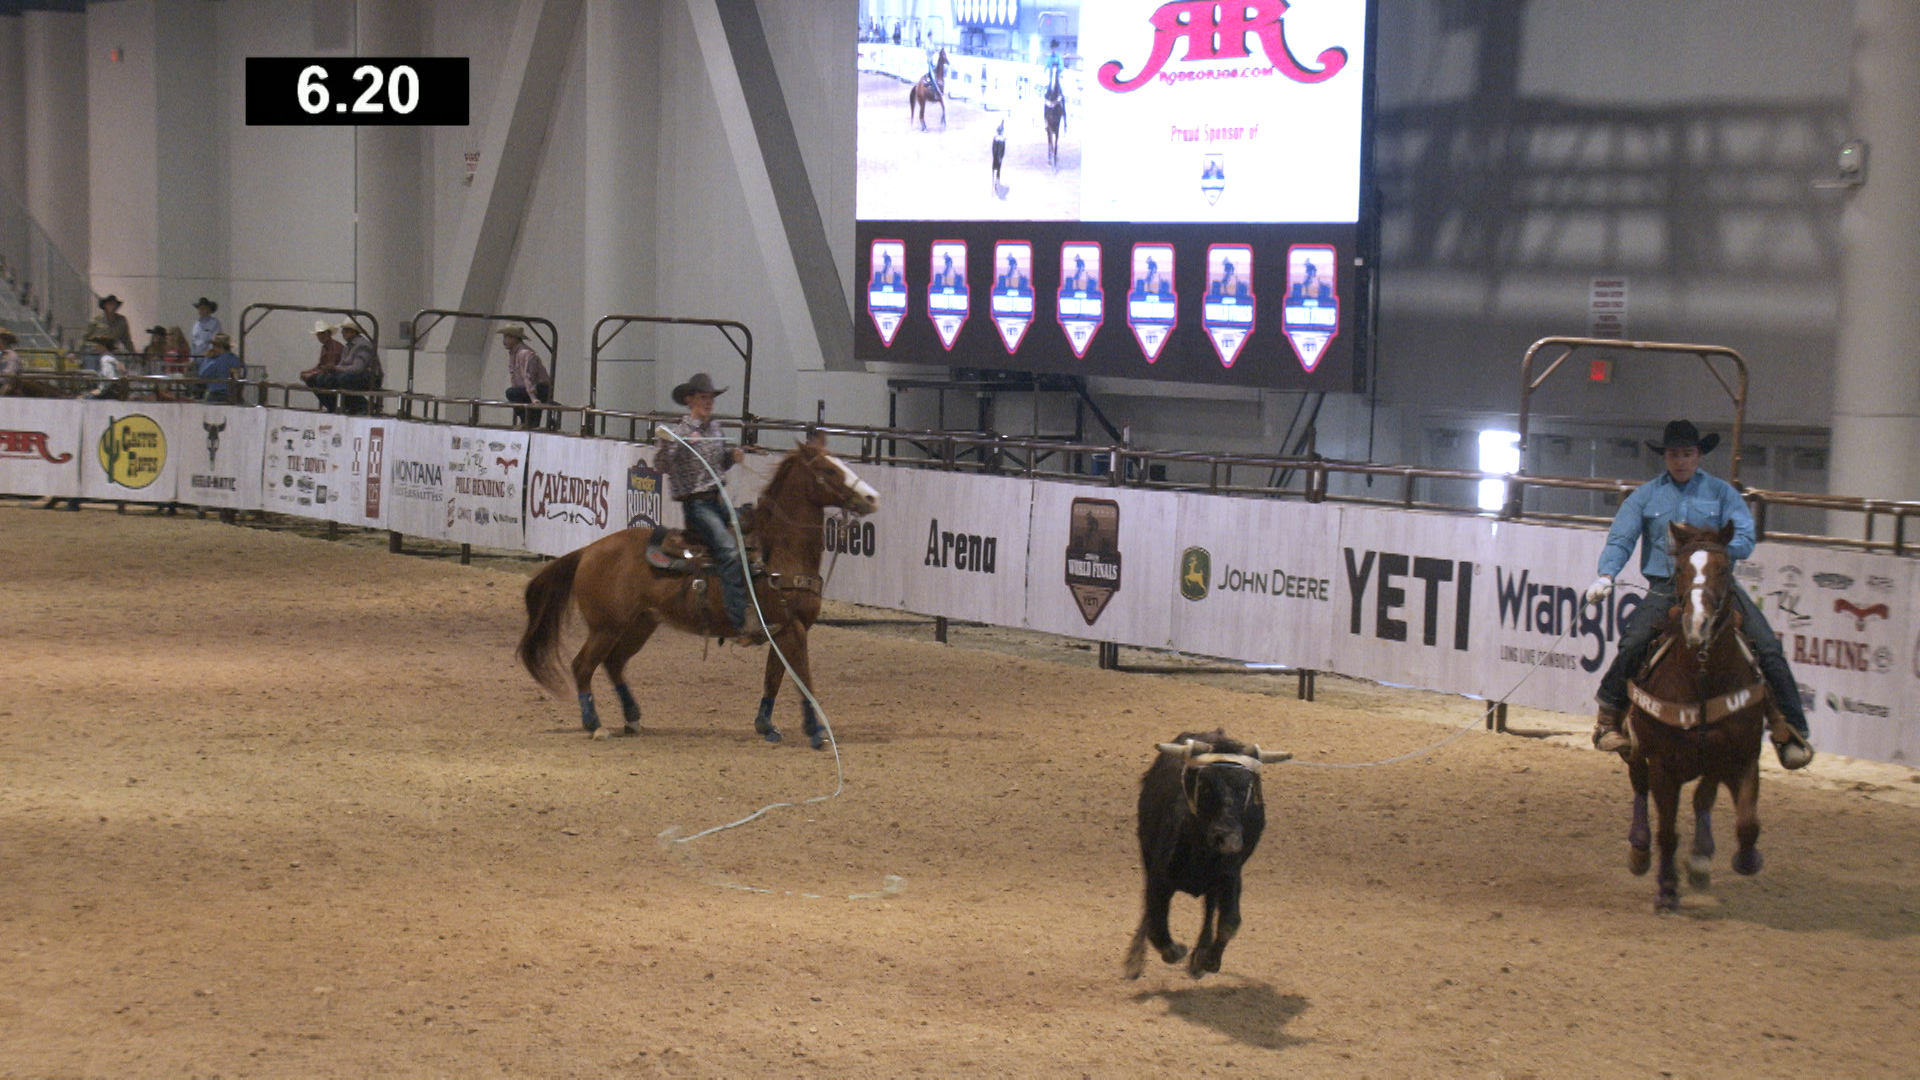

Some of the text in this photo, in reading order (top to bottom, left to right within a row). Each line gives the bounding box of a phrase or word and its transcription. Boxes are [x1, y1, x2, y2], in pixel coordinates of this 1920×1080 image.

[1171, 125, 1200, 142] Proud
[1204, 123, 1245, 145] Sponsor
[392, 460, 443, 486] MONTANA
[456, 476, 505, 498] POLE BENDING
[530, 469, 610, 530] CAVENDER'S
[628, 489, 660, 526] RODEO
[825, 515, 997, 574] odeo Arena
[1068, 559, 1118, 580] WORLD FINALS
[1218, 563, 1330, 601] JOHN DEERE
[1344, 547, 1473, 651] YETI
[1496, 565, 1643, 673] Wrangle
[1794, 633, 1869, 672] RACING
[1633, 687, 1751, 723] FIRE IT UP
